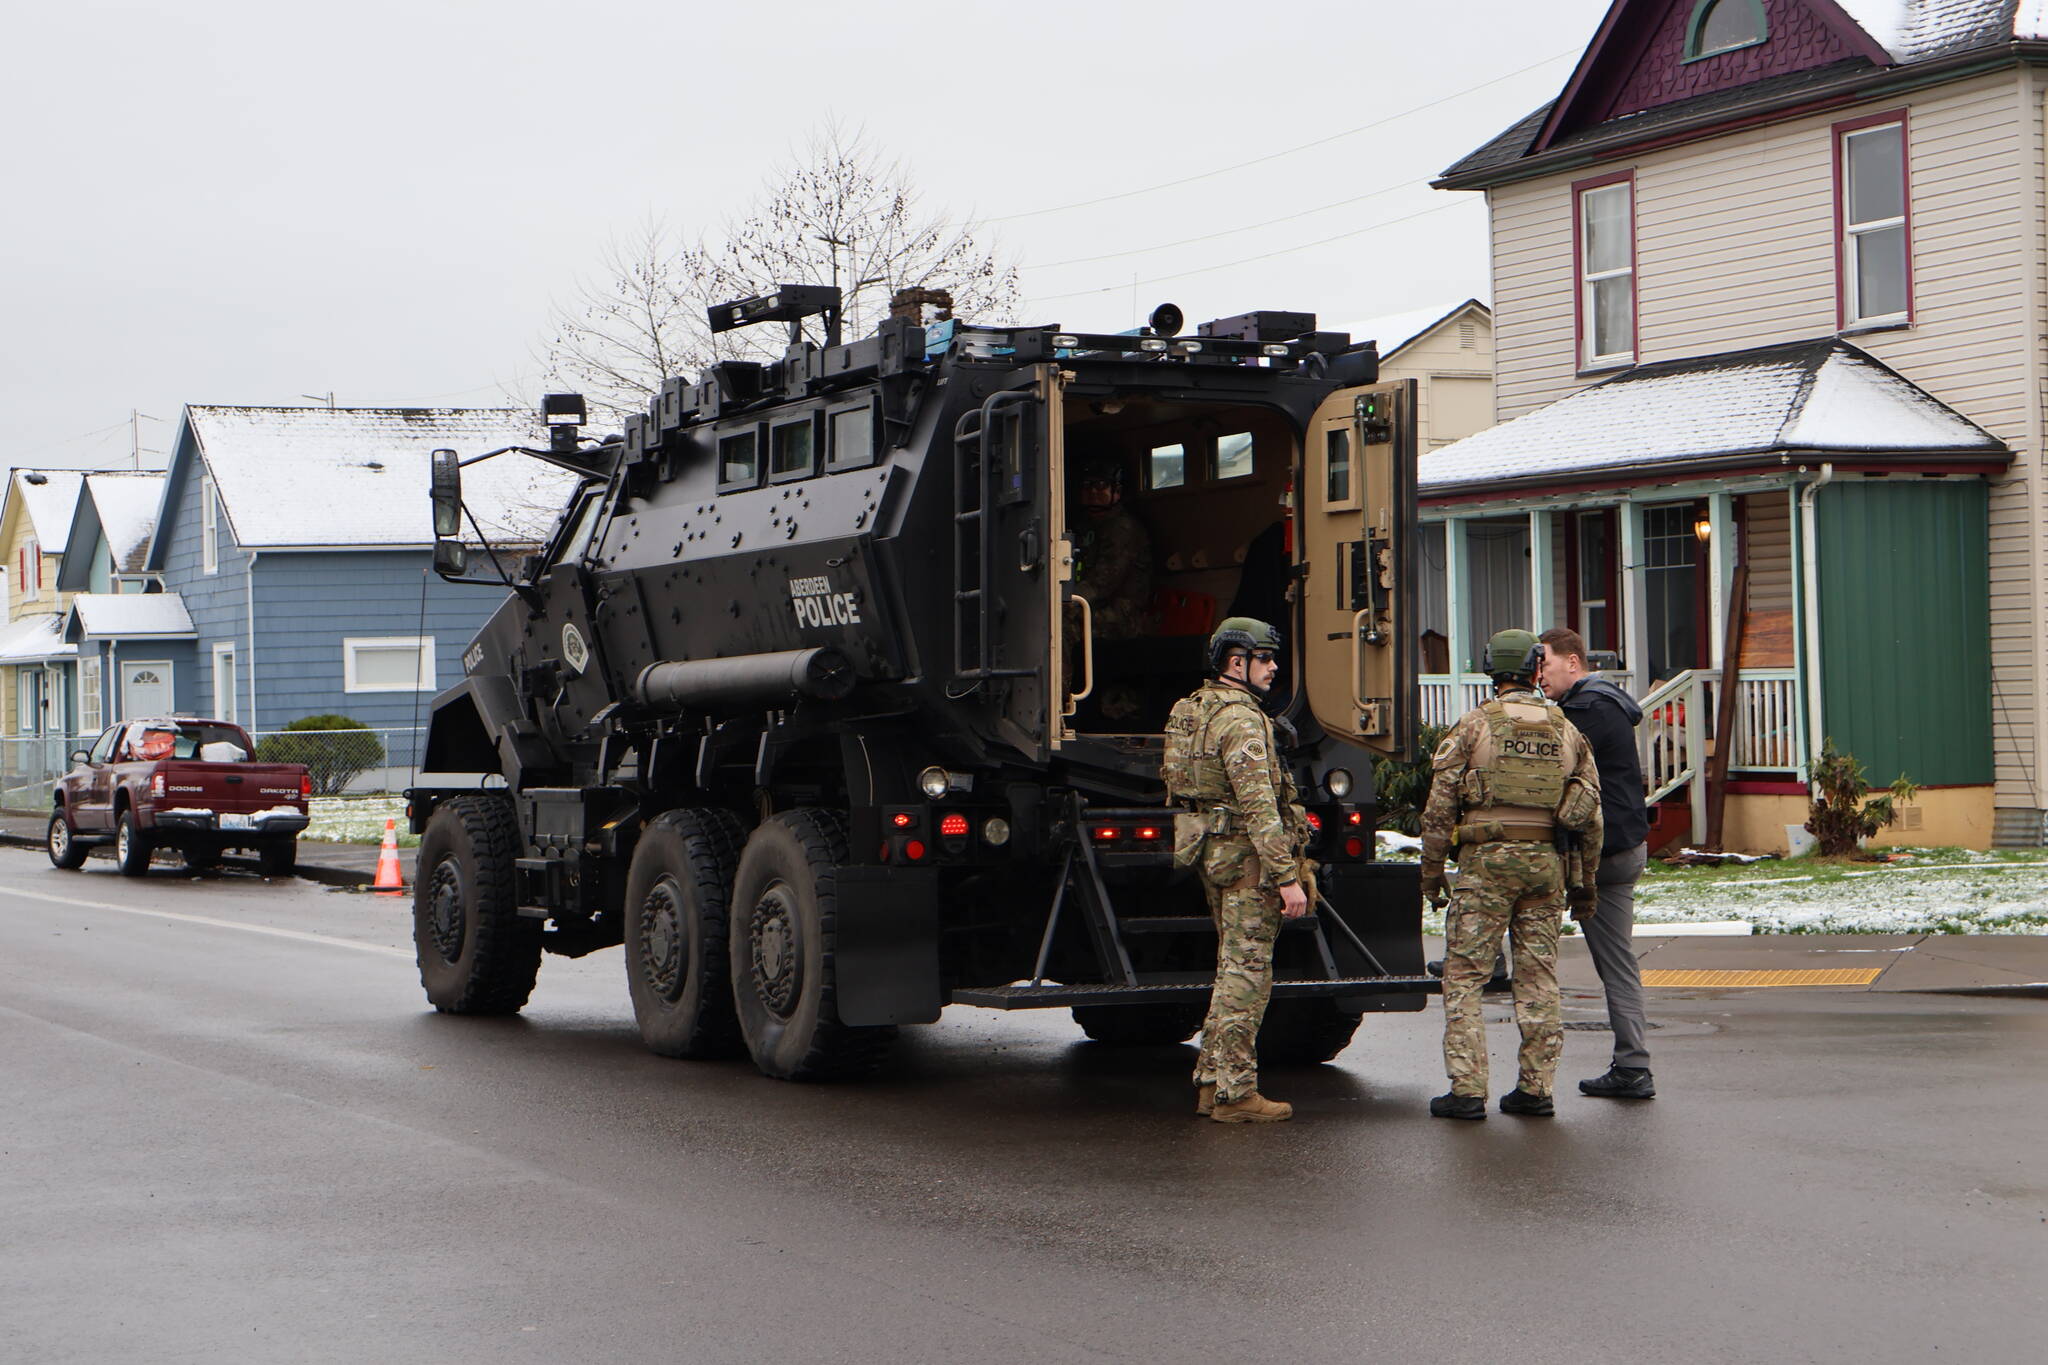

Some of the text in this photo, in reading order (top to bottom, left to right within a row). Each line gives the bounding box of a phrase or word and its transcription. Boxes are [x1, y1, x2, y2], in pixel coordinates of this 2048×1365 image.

[790, 576, 832, 597] ABERDEEN
[793, 592, 861, 629] POLICE
[464, 642, 485, 675] POLICE
[1504, 740, 1560, 757] POLICE
